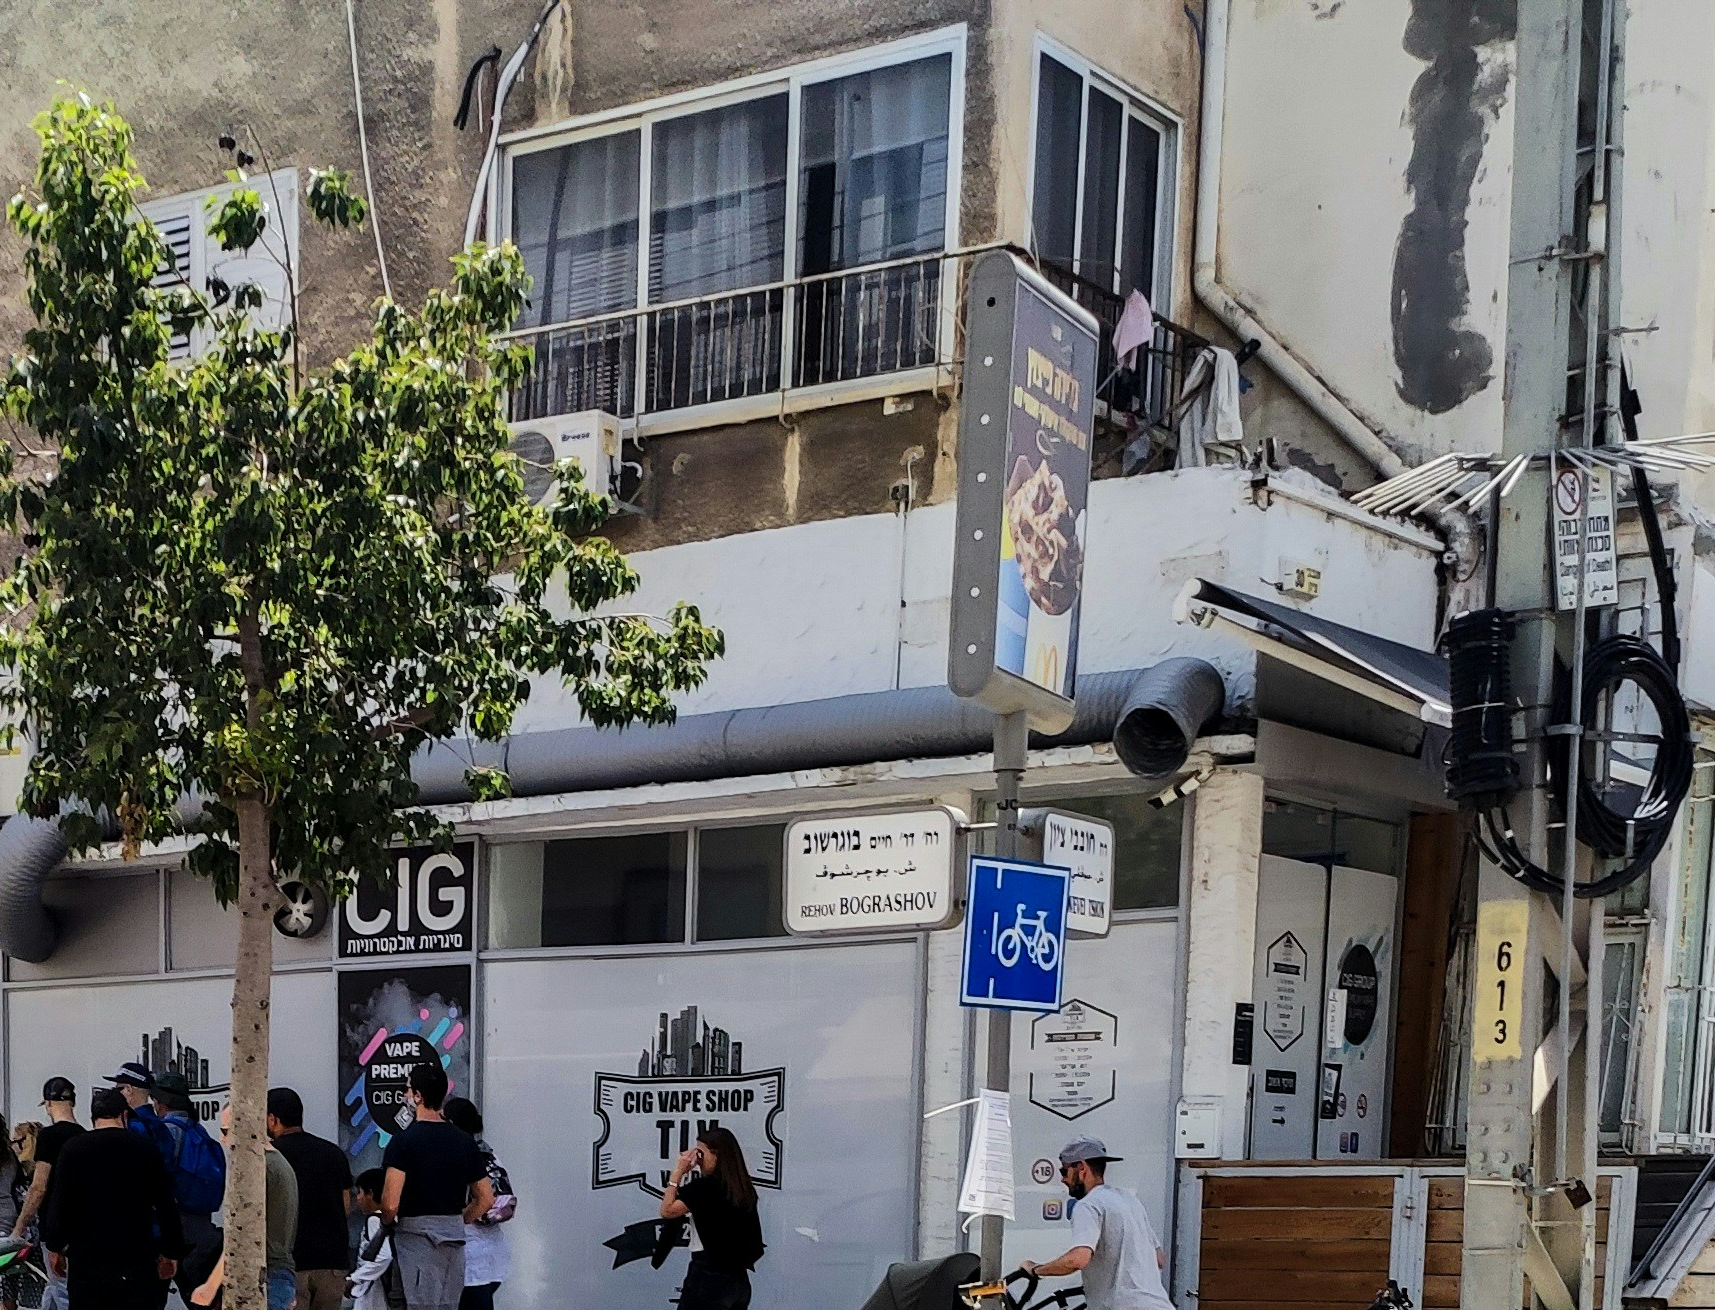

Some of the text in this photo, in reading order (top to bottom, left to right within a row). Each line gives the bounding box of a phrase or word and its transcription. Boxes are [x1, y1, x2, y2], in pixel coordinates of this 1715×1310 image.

[802, 829, 861, 855] בוגרשוב
[869, 834, 893, 850] חיים
[346, 852, 466, 936] CIG
[800, 891, 938, 918] REHOV BOGRASHOV
[418, 933, 463, 950] סיגריות
[385, 1041, 421, 1058] VAPE
[372, 1090, 393, 1105] CIG
[623, 1088, 754, 1114] CIG VAPE SHOP
